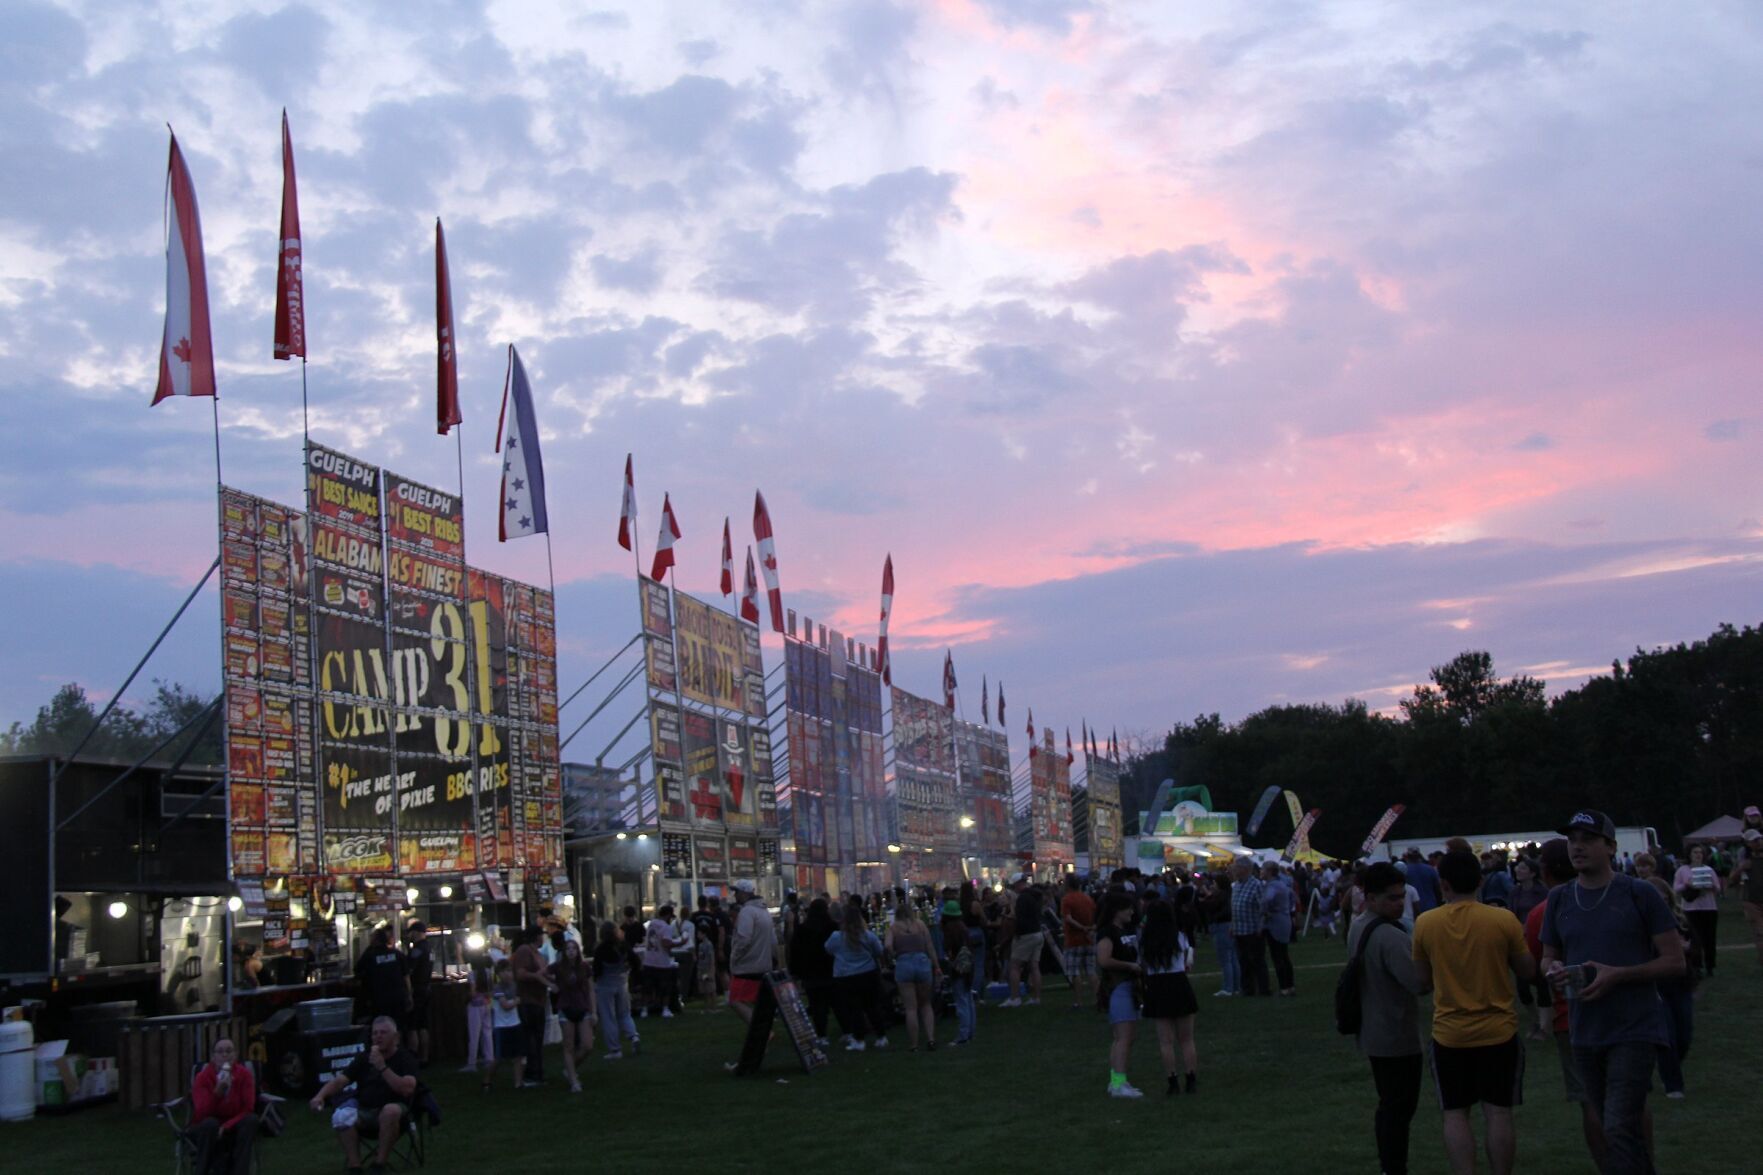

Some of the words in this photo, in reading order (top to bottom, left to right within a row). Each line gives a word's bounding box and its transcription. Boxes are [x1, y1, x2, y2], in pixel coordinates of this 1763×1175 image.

[310, 450, 374, 487] GUELPH
[323, 478, 346, 505] BEST
[347, 487, 378, 516] SAUCE
[398, 483, 451, 513] GUELPH
[403, 505, 432, 534] BEST
[434, 517, 460, 545] RIBS
[413, 561, 463, 595] FINEST
[322, 648, 429, 739] CAMP
[431, 600, 501, 762] 31
[346, 778, 371, 799] THE
[480, 762, 509, 792] RIBS
[400, 784, 435, 812] DIXIE
